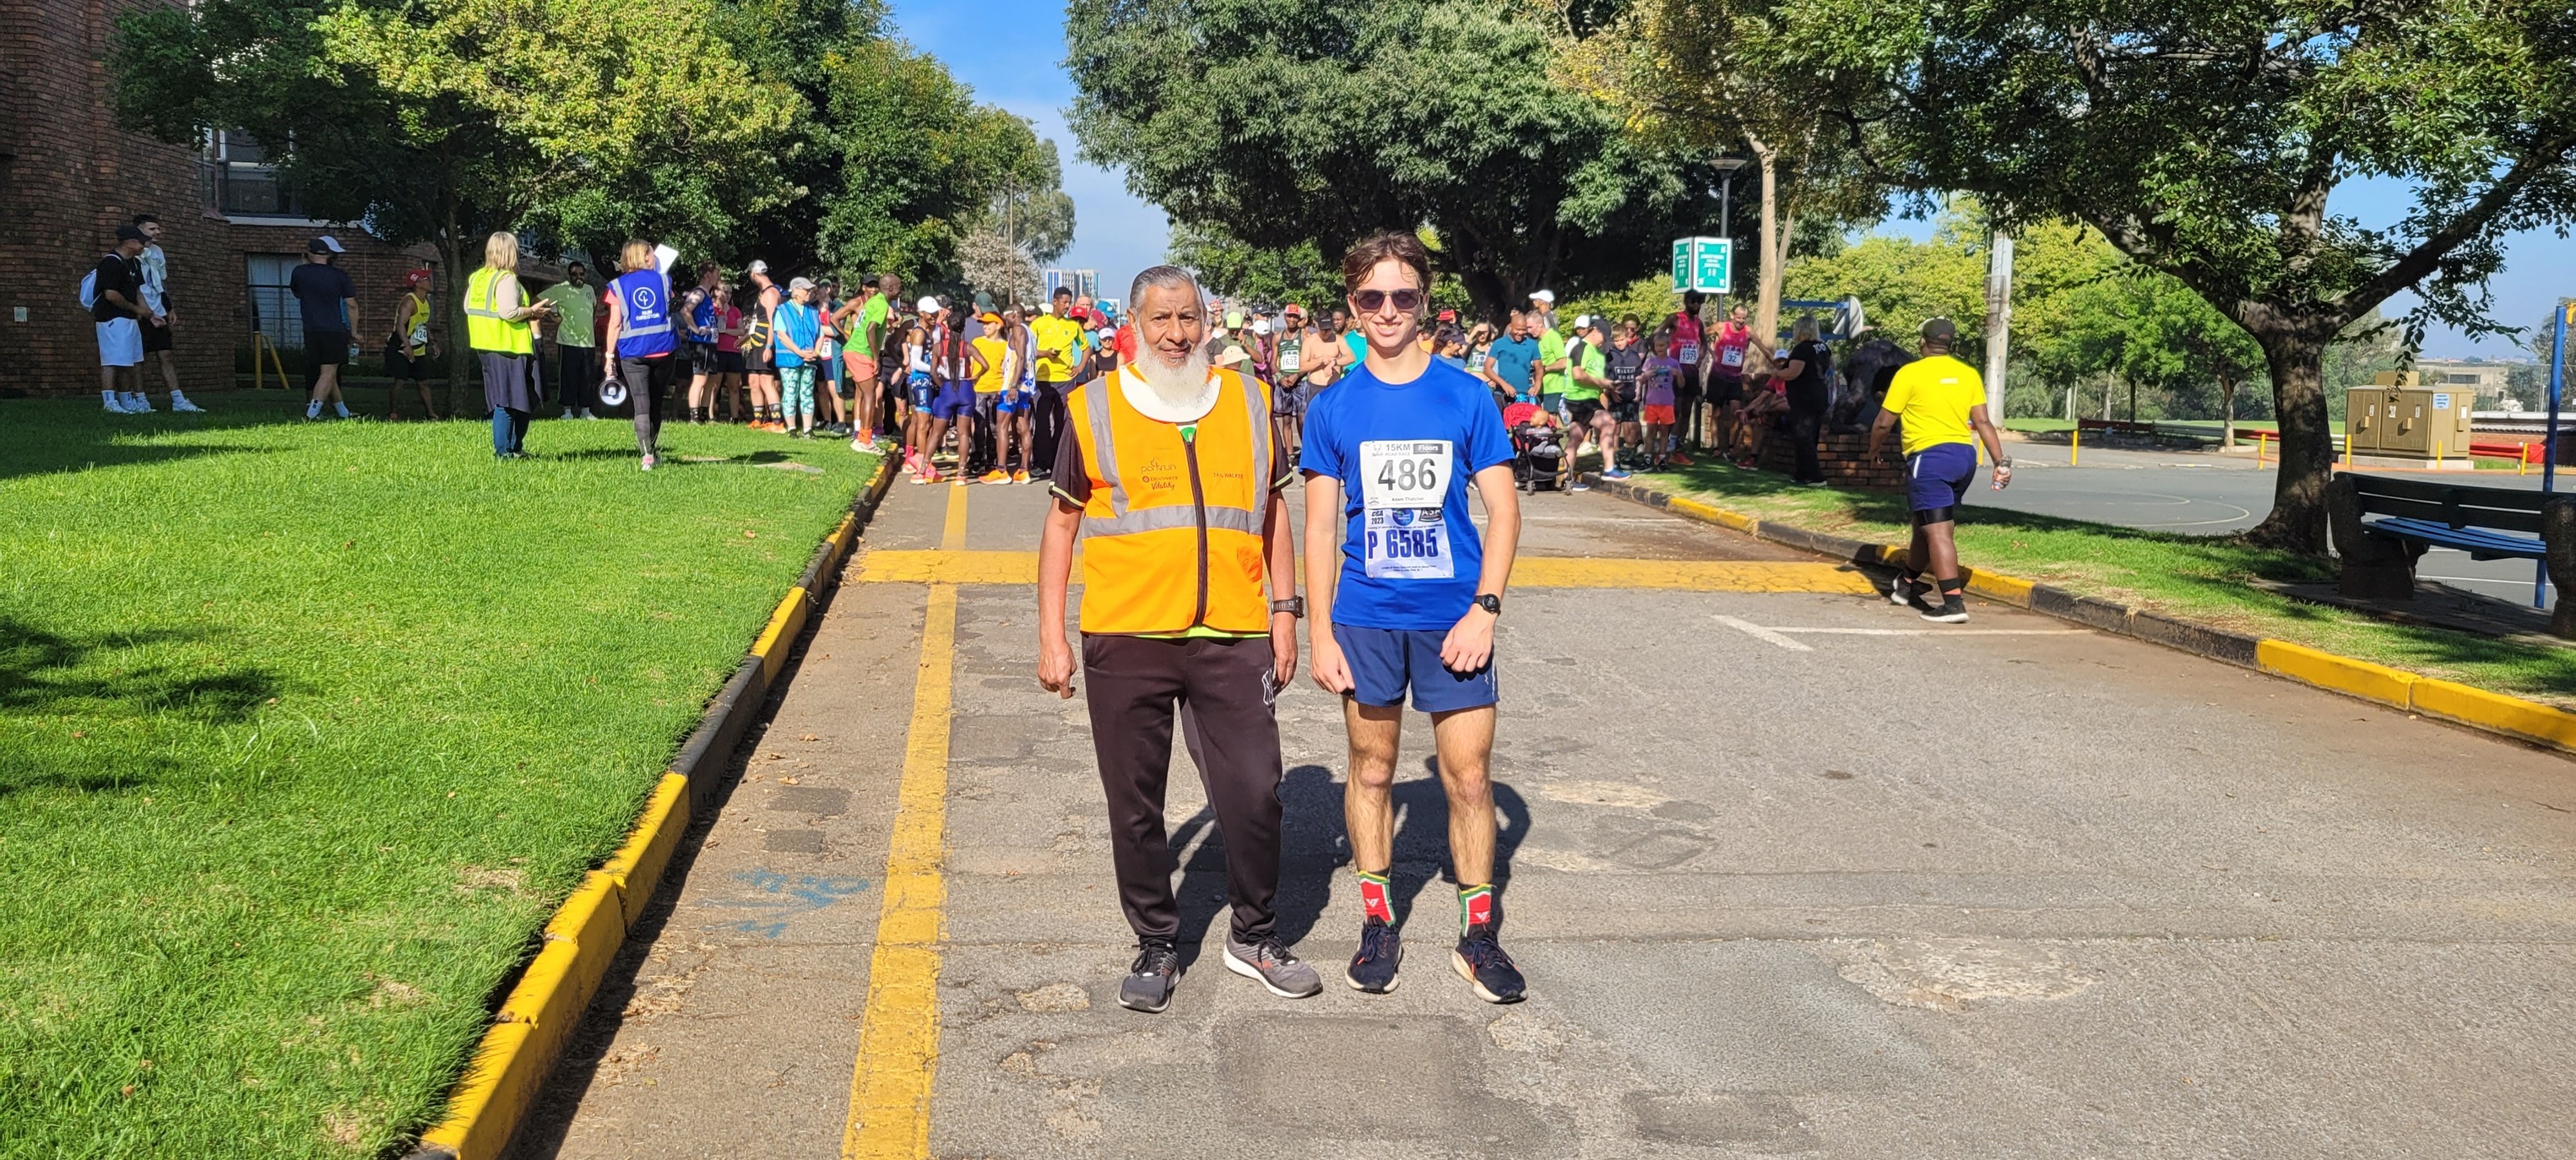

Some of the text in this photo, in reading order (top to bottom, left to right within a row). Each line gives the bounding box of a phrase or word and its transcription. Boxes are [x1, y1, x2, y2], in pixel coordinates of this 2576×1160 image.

[1812, 343, 1826, 355] 100
[1683, 352, 1696, 360] 1375
[1386, 443, 1411, 452] 15KM
[1141, 458, 1176, 473] parkrun
[1377, 458, 1436, 491] 486
[1367, 528, 1439, 559] P 6585
